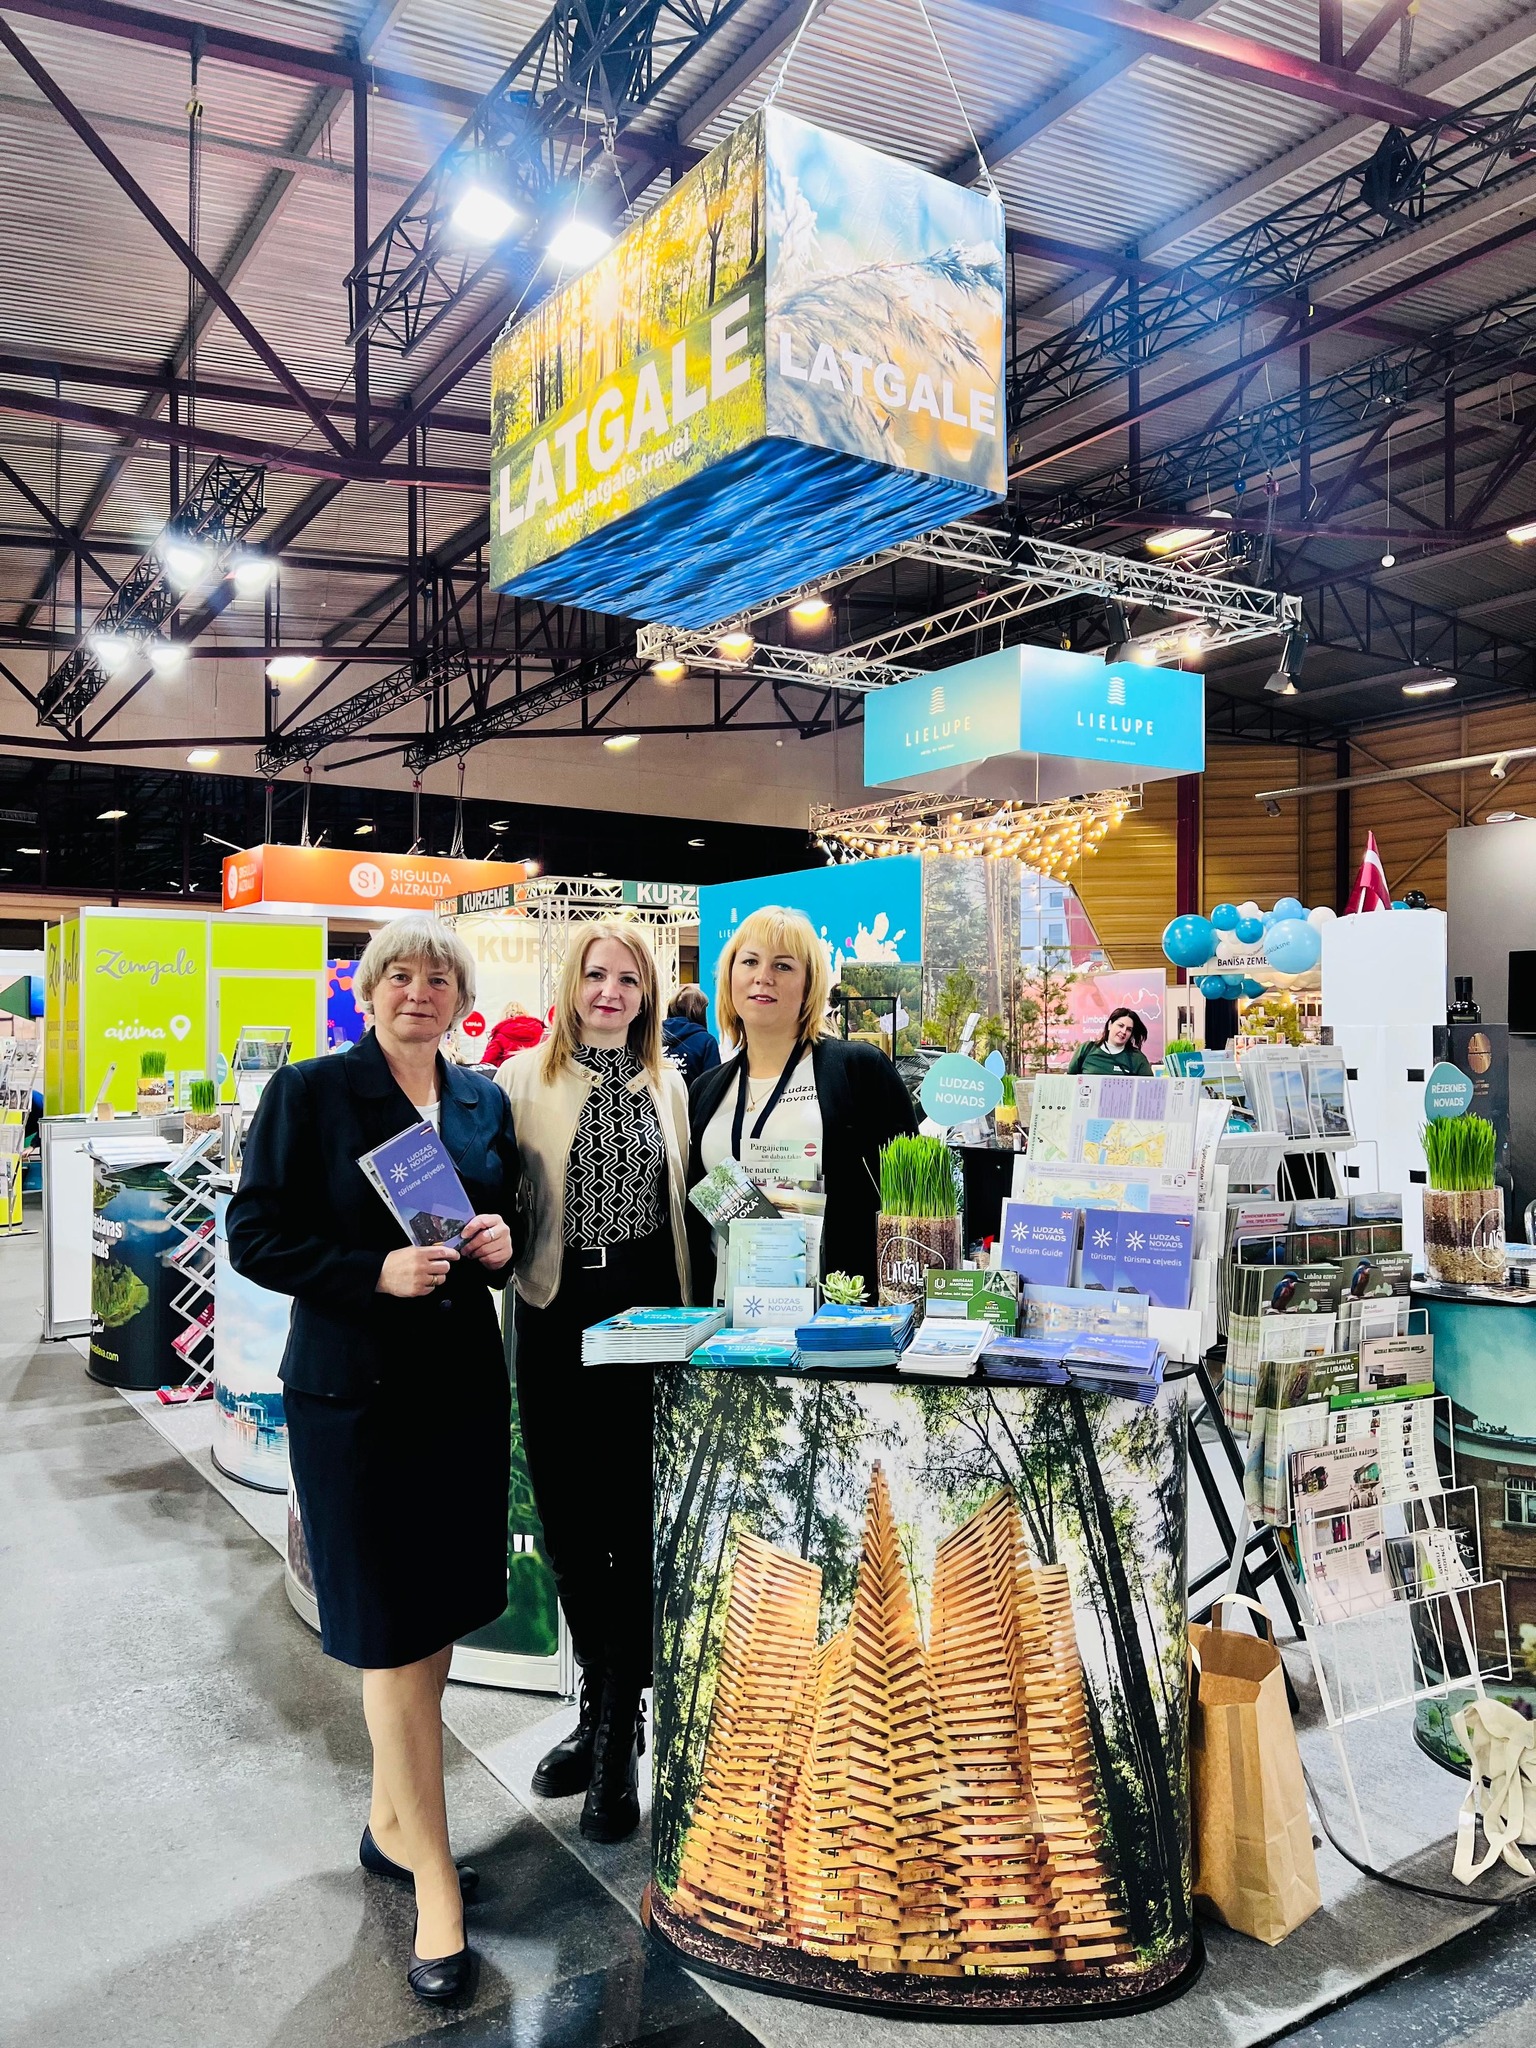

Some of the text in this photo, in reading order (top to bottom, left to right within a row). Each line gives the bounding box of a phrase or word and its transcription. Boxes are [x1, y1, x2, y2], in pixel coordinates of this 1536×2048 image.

[779, 331, 996, 436] LATGALE
[500, 292, 751, 537] LATGALE
[545, 426, 691, 534] www.latgale.travel
[905, 716, 971, 747] LIELUPE
[1077, 711, 1154, 736] LIELUPE
[390, 883, 444, 897] AIZRAUJ
[636, 883, 699, 905] KURZ
[462, 886, 510, 914] KURZEME
[477, 935, 550, 963] KUR
[96, 948, 197, 985] Zemgale
[781, 1085, 817, 1095] Ludza
[939, 1076, 985, 1092] LUDZAS
[1431, 1082, 1467, 1094] RĒZEKNES
[935, 1092, 985, 1108] NOVADS
[1433, 1097, 1464, 1108] NOVADS
[406, 1143, 433, 1164] LUDZAS
[409, 1147, 438, 1170] NOVADS
[755, 1166, 780, 1174] nature
[398, 1162, 446, 1197] tūrisma ceļvedis
[1032, 1233, 1067, 1242] NOVADS
[1033, 1226, 1064, 1235] LUDZAS
[1149, 1233, 1181, 1242] LUDZAS
[1010, 1245, 1063, 1257] Tourism Guide
[1148, 1240, 1183, 1249] NOVADS
[1124, 1255, 1182, 1267] tūrisma ceļvedis
